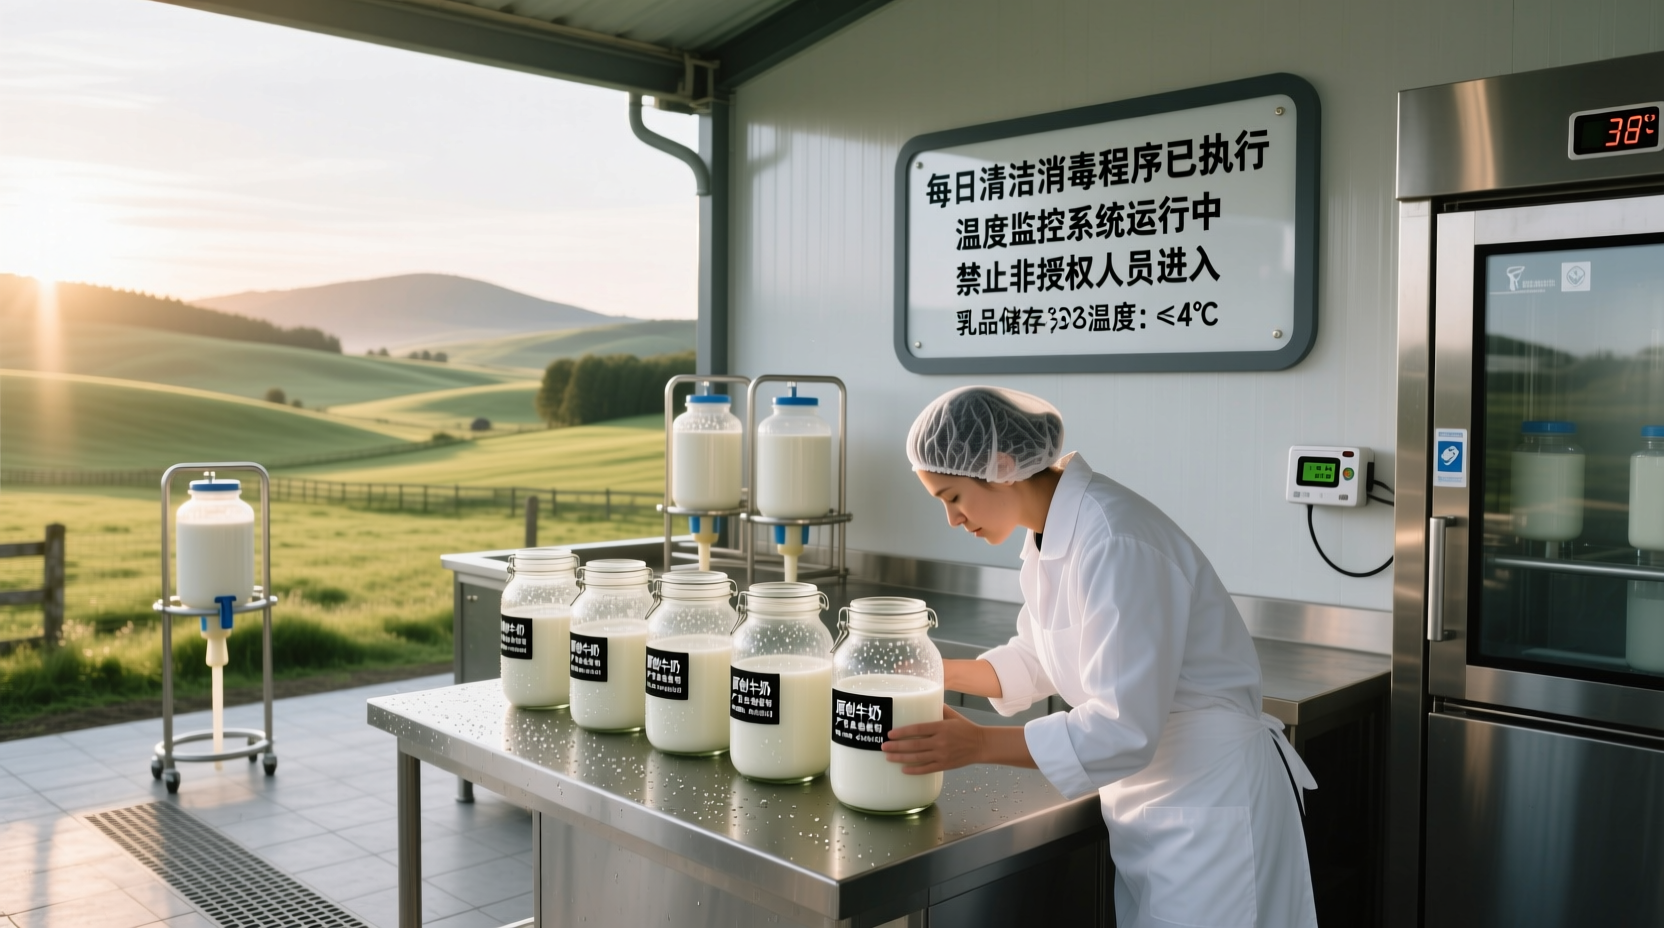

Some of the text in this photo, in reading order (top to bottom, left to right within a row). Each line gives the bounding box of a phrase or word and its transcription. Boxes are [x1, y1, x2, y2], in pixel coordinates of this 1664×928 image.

[926, 129, 1270, 209] 每日清洁消毒程序已执行
[955, 191, 1221, 251] 温度监控系统运行中
[956, 245, 1221, 297] 禁止非授权人员进入
